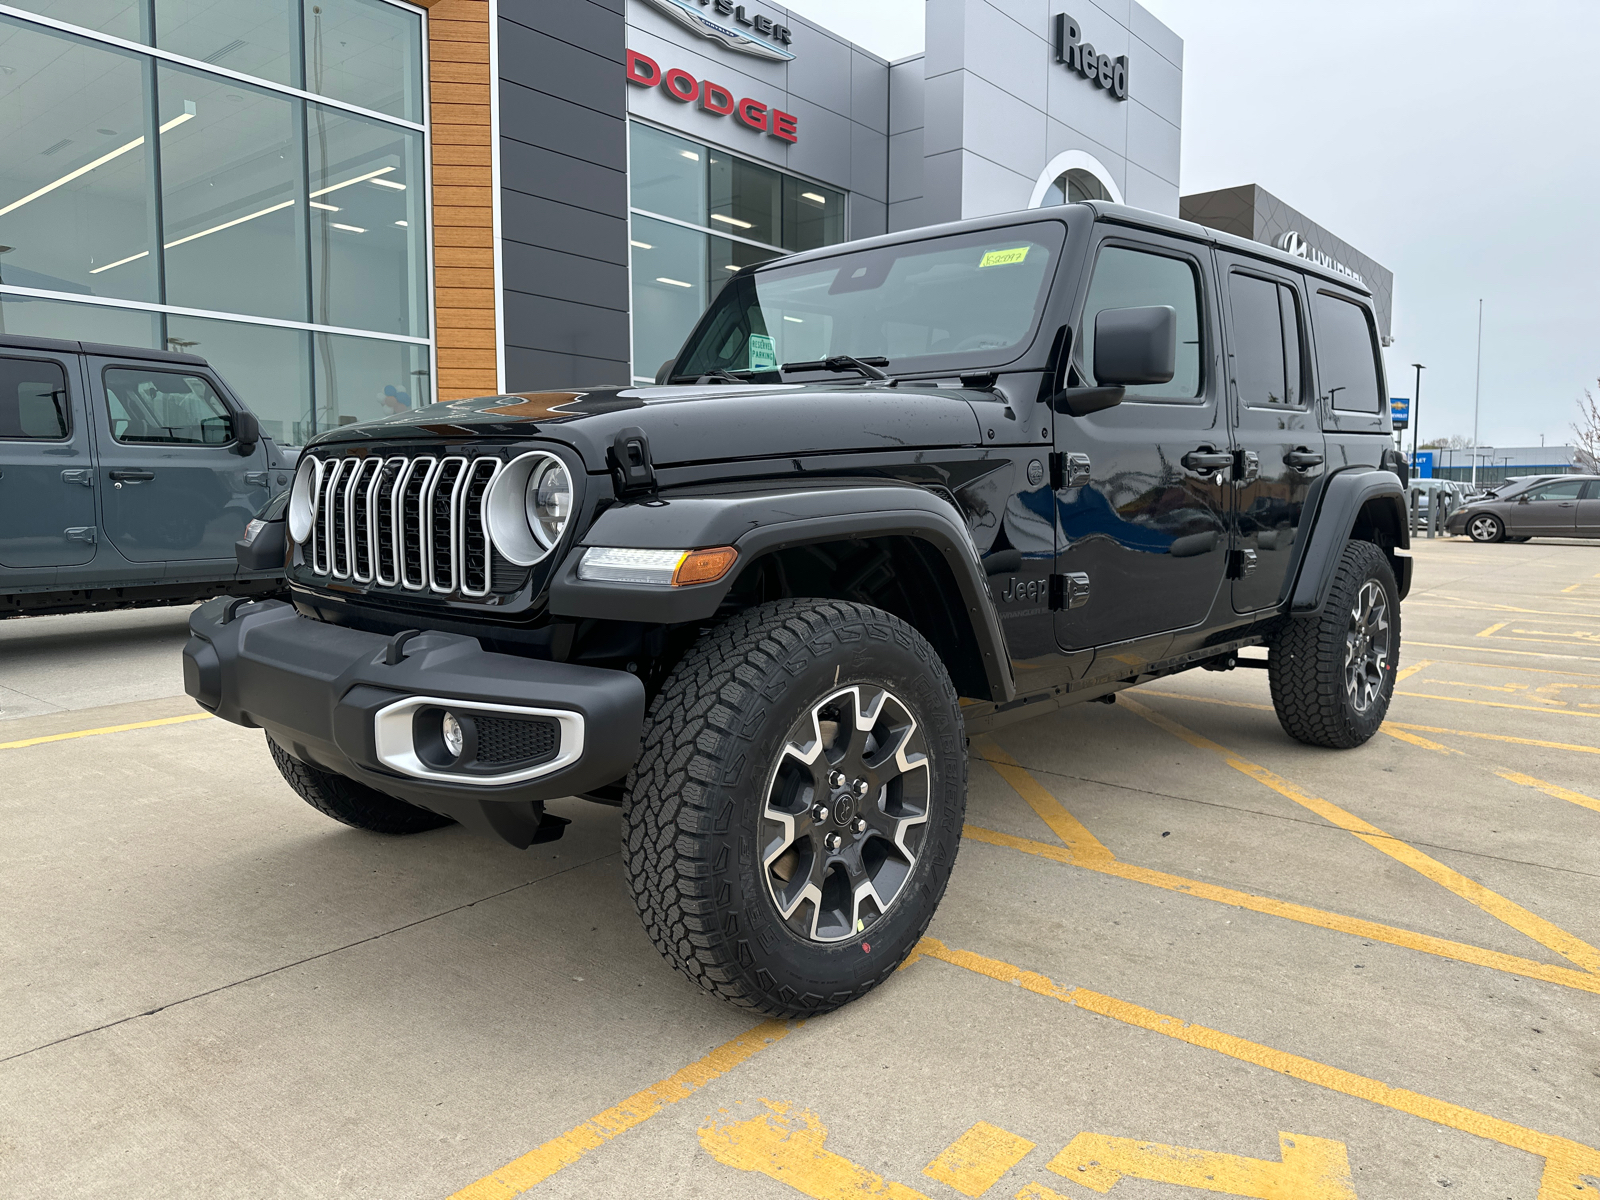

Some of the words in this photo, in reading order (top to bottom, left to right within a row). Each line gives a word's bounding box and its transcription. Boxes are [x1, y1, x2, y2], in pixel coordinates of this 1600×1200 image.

[1056, 12, 1129, 102] Reed
[626, 48, 798, 144] DODGE
[752, 350, 773, 361] PARKING
[1001, 577, 1048, 604] Jeep
[1001, 609, 1043, 620] WRANGLER
